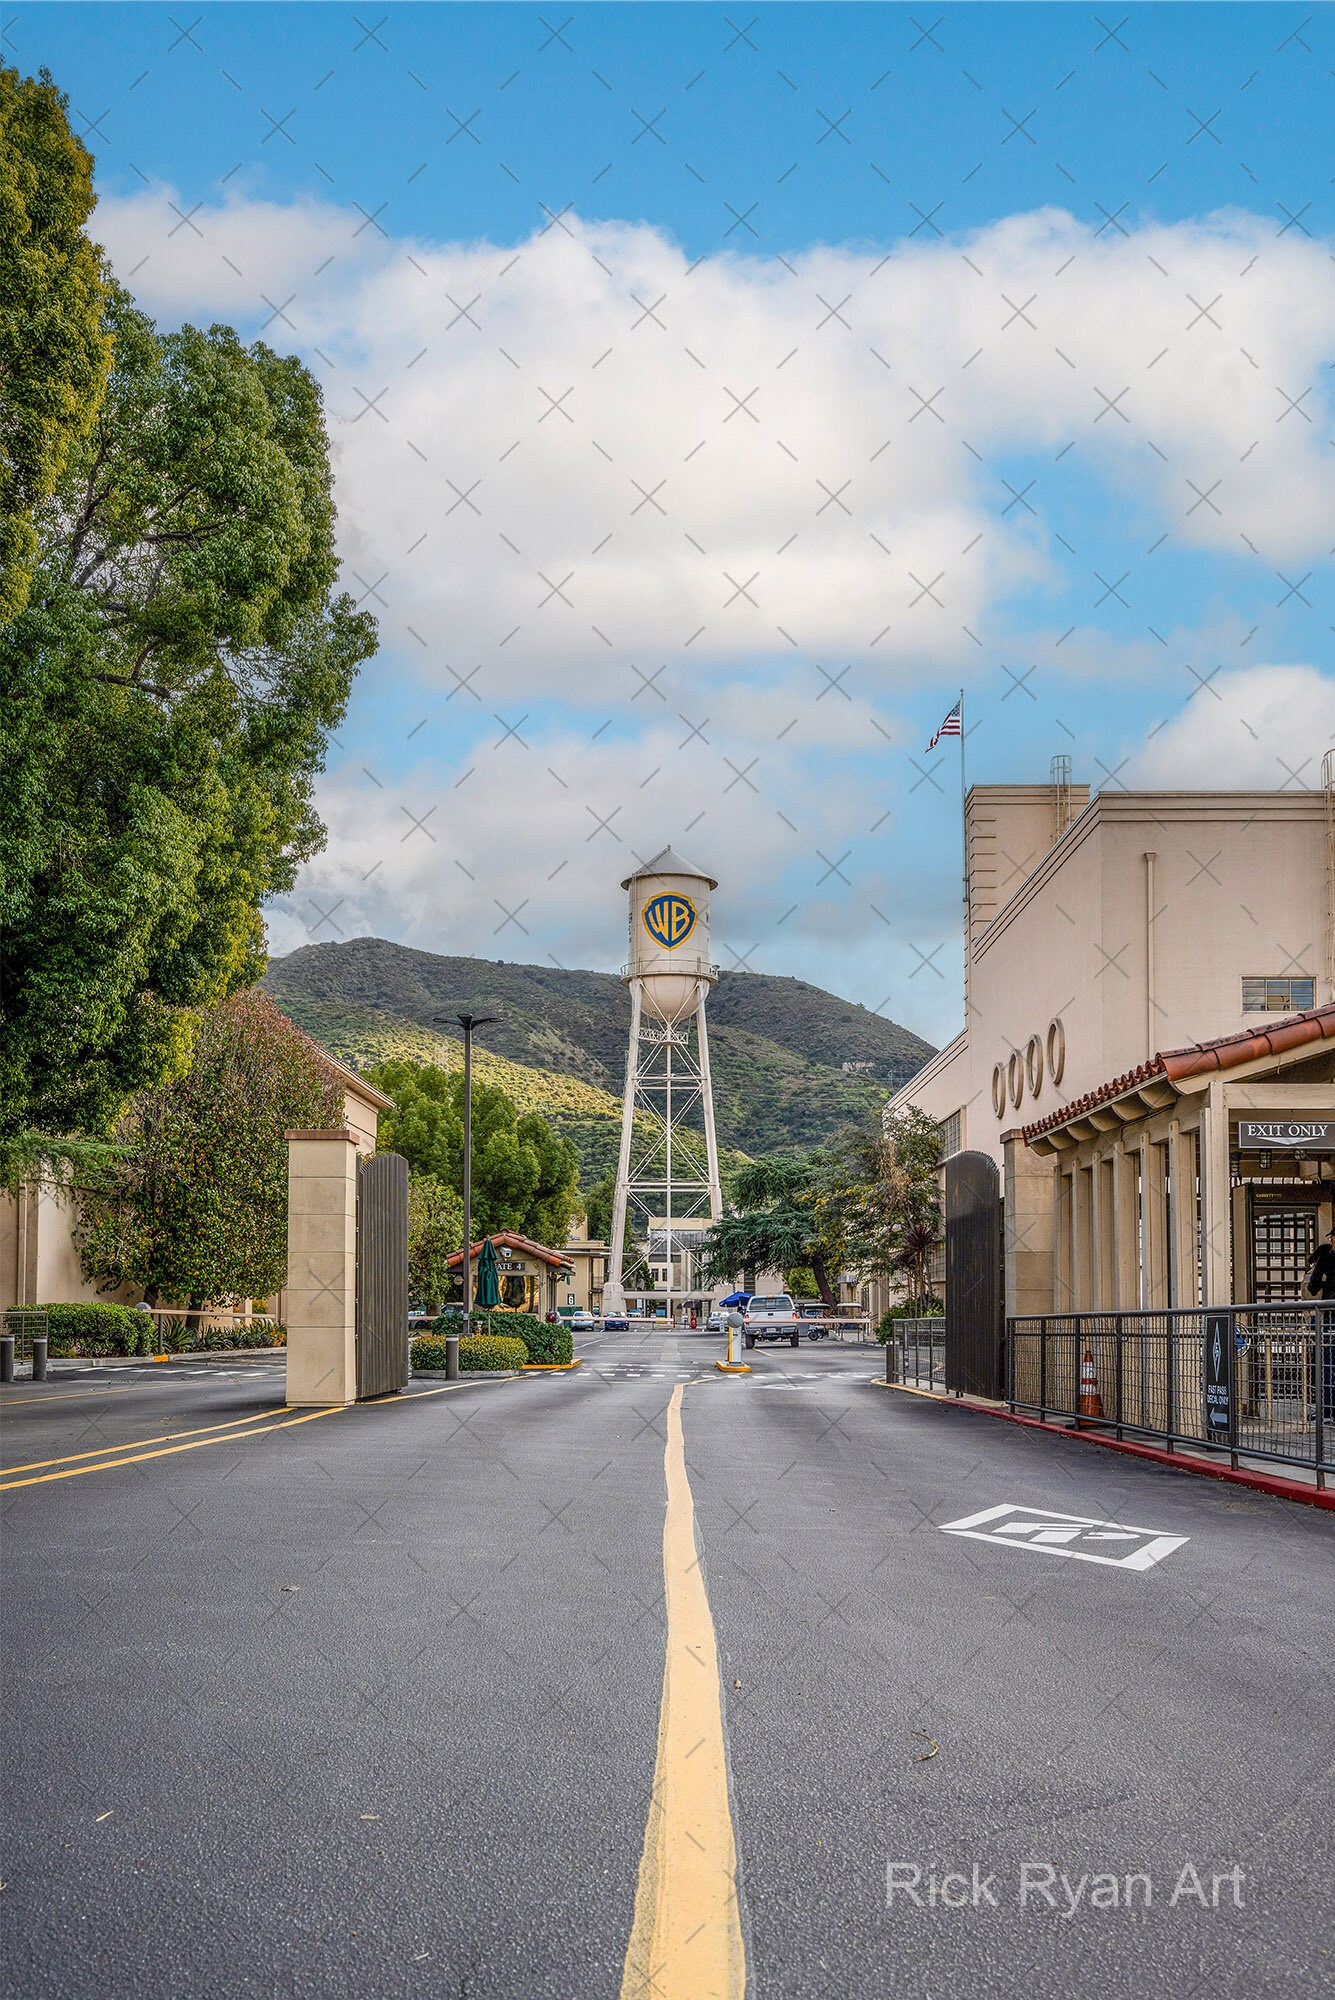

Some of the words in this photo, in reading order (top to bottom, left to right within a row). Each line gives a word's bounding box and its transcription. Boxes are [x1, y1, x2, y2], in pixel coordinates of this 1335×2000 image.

[648, 901, 690, 941] WB
[1247, 1124, 1284, 1136] EXIT
[1288, 1124, 1328, 1136] ONLY
[495, 1262, 513, 1271] ATE
[516, 1262, 522, 1271] 4
[1208, 1385, 1217, 1394] FAST
[1217, 1385, 1227, 1395] PASS
[1207, 1395, 1218, 1404] DECAL
[1219, 1395, 1228, 1405] ONLY
